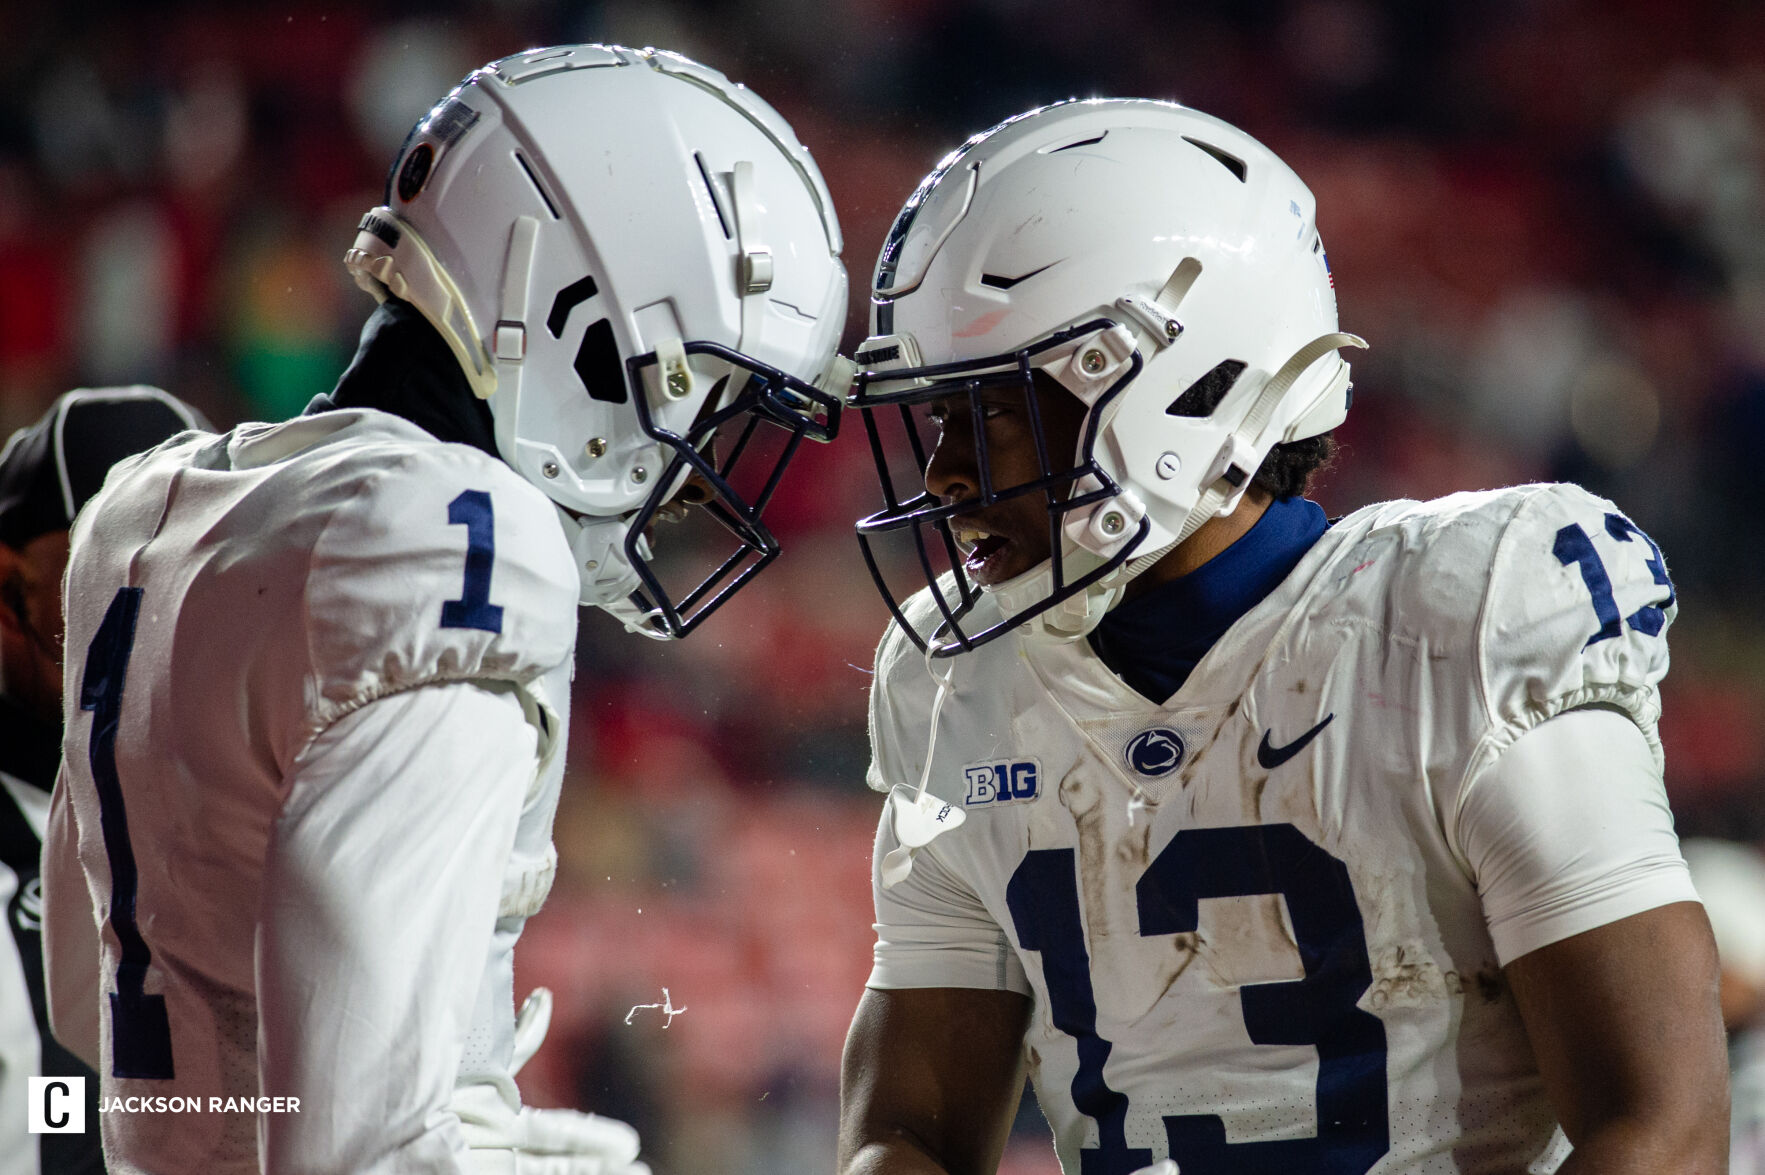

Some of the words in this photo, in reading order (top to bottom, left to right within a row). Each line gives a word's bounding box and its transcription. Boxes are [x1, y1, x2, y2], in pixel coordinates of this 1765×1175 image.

[440, 488, 504, 633] 1
[1552, 512, 1676, 654] 13
[80, 586, 175, 1080] 1
[1006, 822, 1391, 1175] 13
